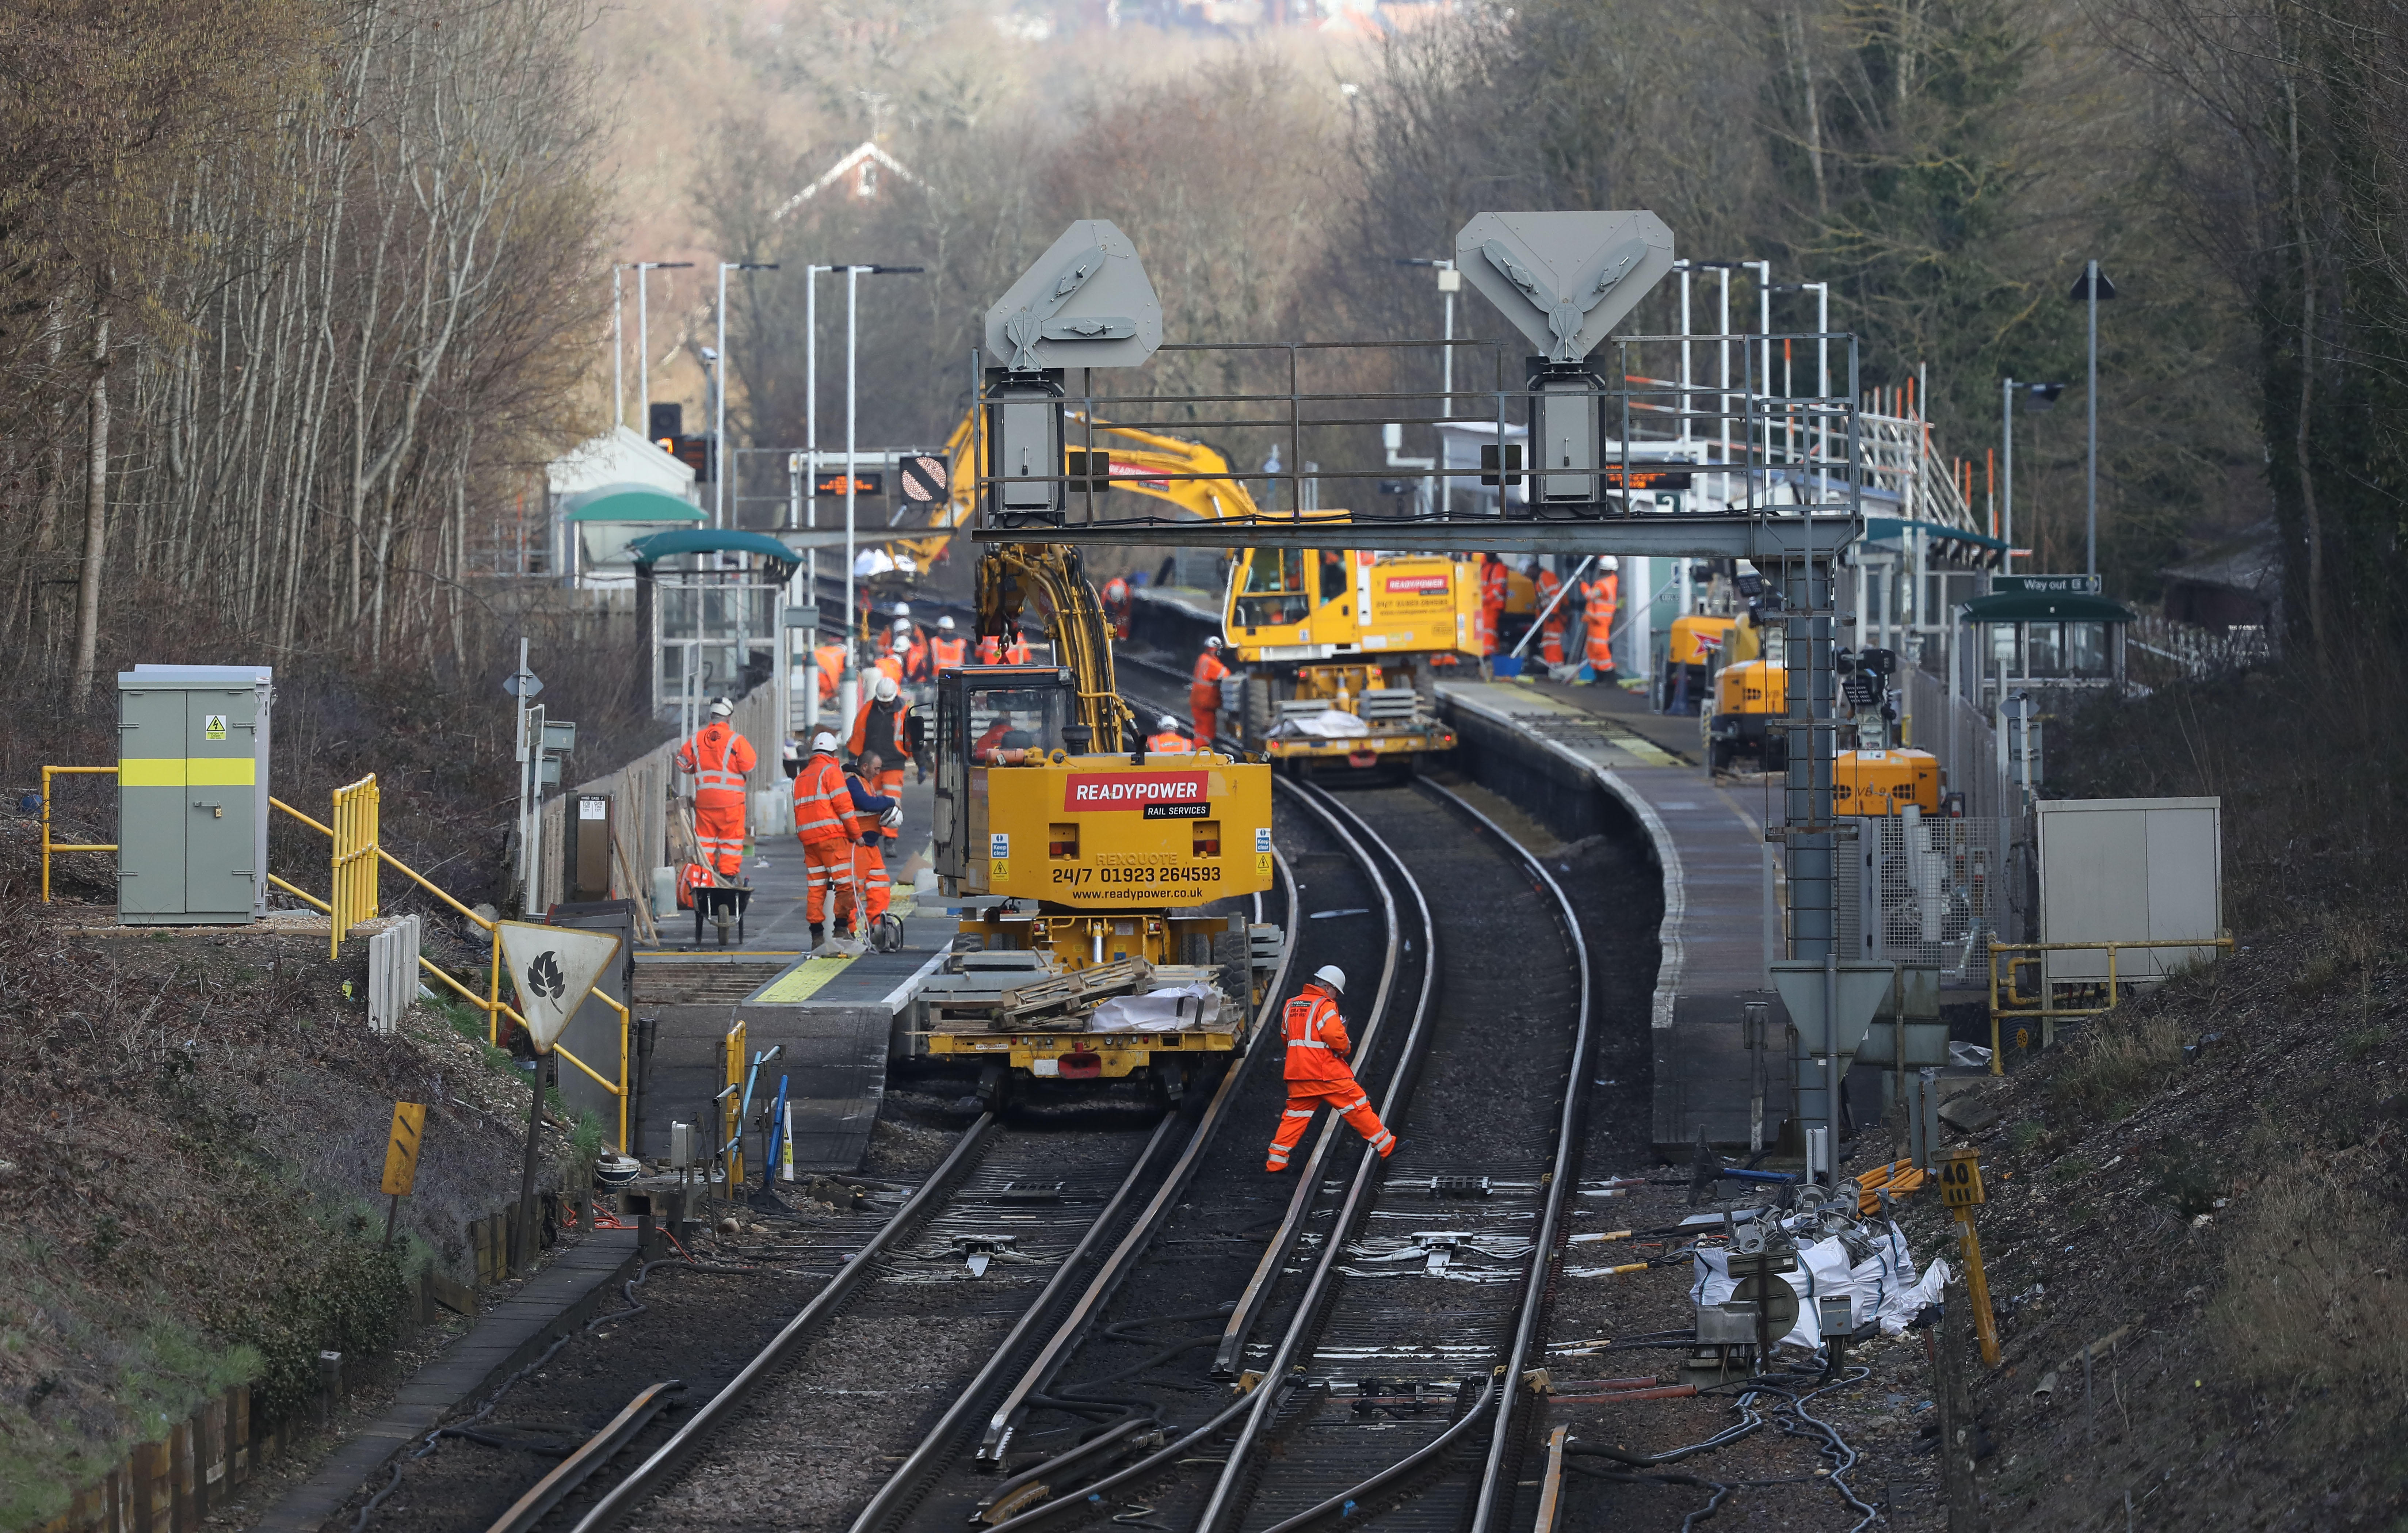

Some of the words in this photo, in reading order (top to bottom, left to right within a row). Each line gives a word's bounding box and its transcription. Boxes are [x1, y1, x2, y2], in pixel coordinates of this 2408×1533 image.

[2024, 579, 2047, 592] Way
[2049, 580, 2067, 590] out
[1076, 782, 1198, 800] READYPOWER
[1169, 806, 1206, 815] SERVICES
[1096, 852, 1178, 866] REXQUOTE
[1053, 868, 1092, 886] 24/7
[1100, 868, 1155, 882] 01923
[1159, 867, 1220, 881] 264593
[1072, 887, 1202, 900] www.readypower.co.uk
[2018, 1033, 2027, 1044] 58
[1943, 1162, 1969, 1185] 40
